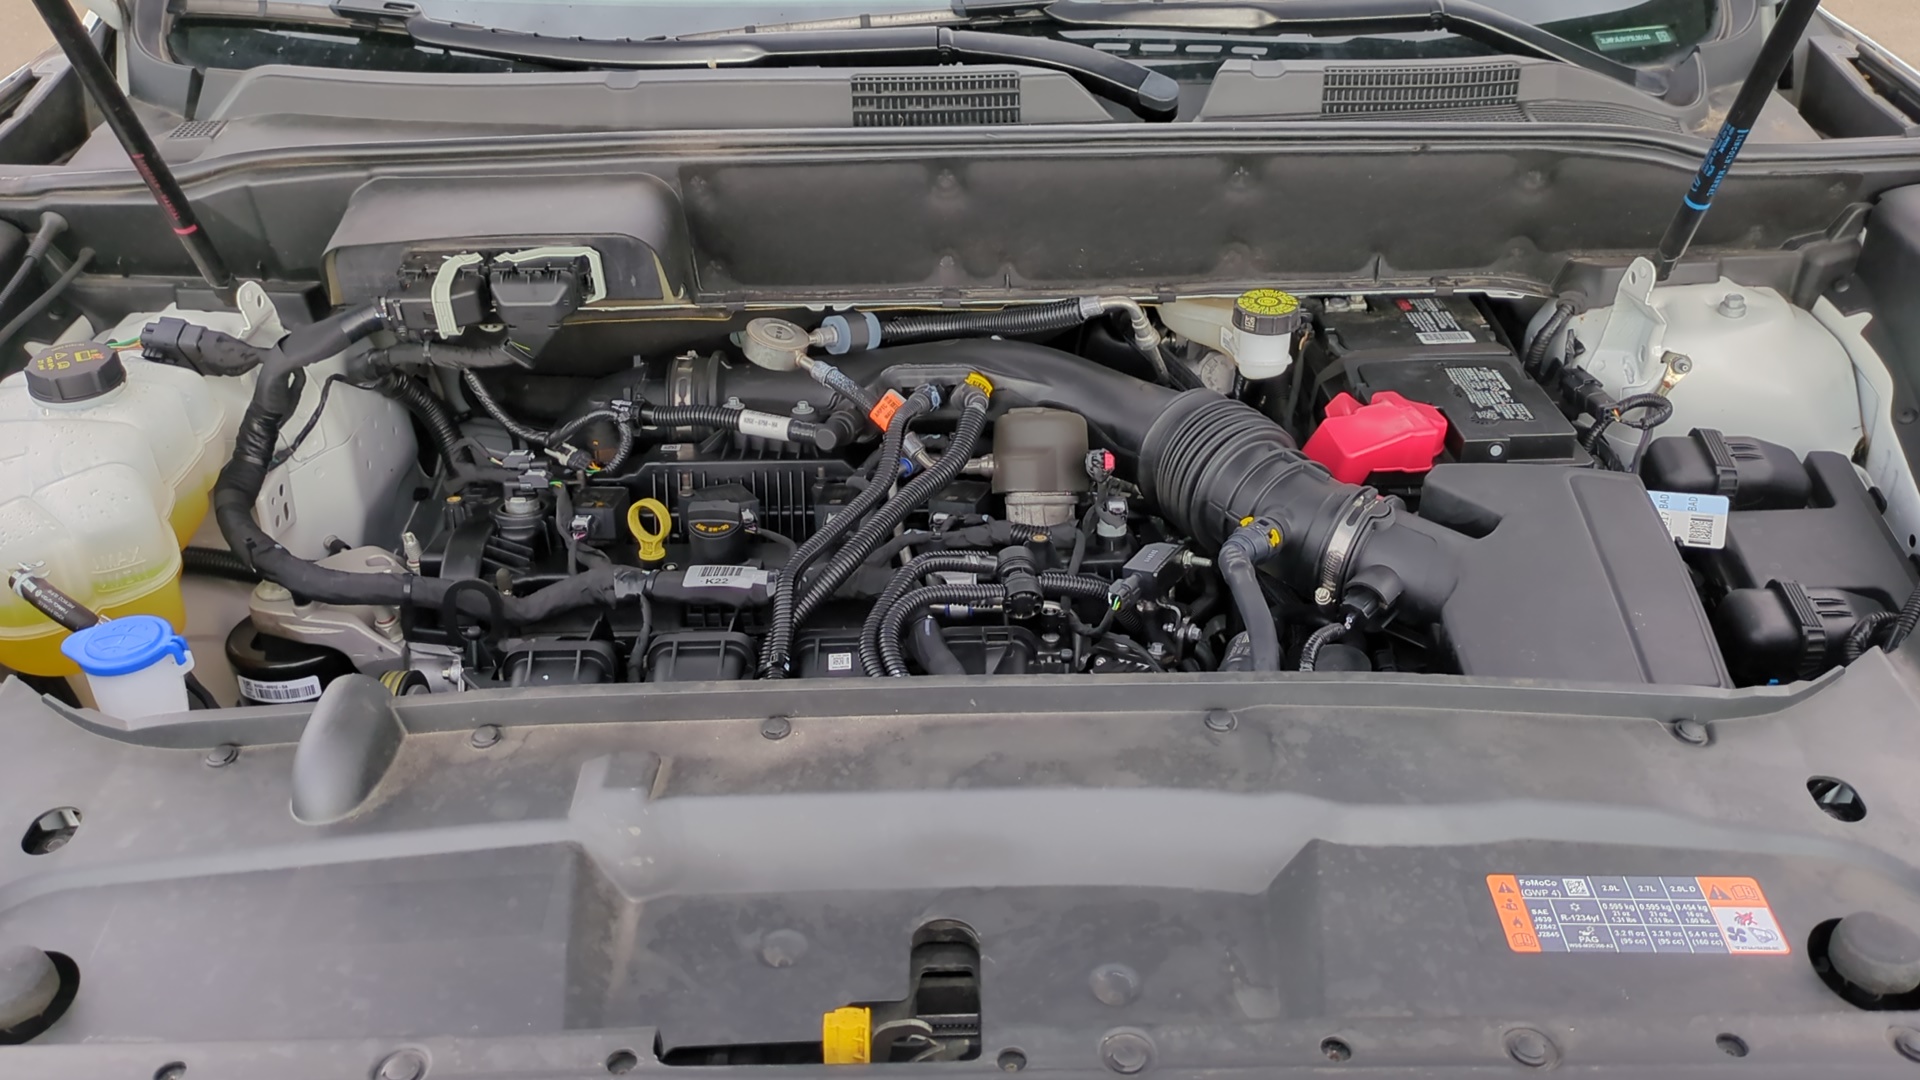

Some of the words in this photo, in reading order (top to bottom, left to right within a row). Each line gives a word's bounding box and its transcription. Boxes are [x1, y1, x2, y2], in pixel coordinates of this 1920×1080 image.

[1659, 494, 1670, 509] BAD
[1687, 496, 1698, 512] BAD
[1521, 889, 1548, 897] (GWP
[1551, 889, 1561, 898] 4)
[1624, 903, 1635, 911] kg
[1662, 903, 1672, 912] kg
[1698, 904, 1708, 912] kg
